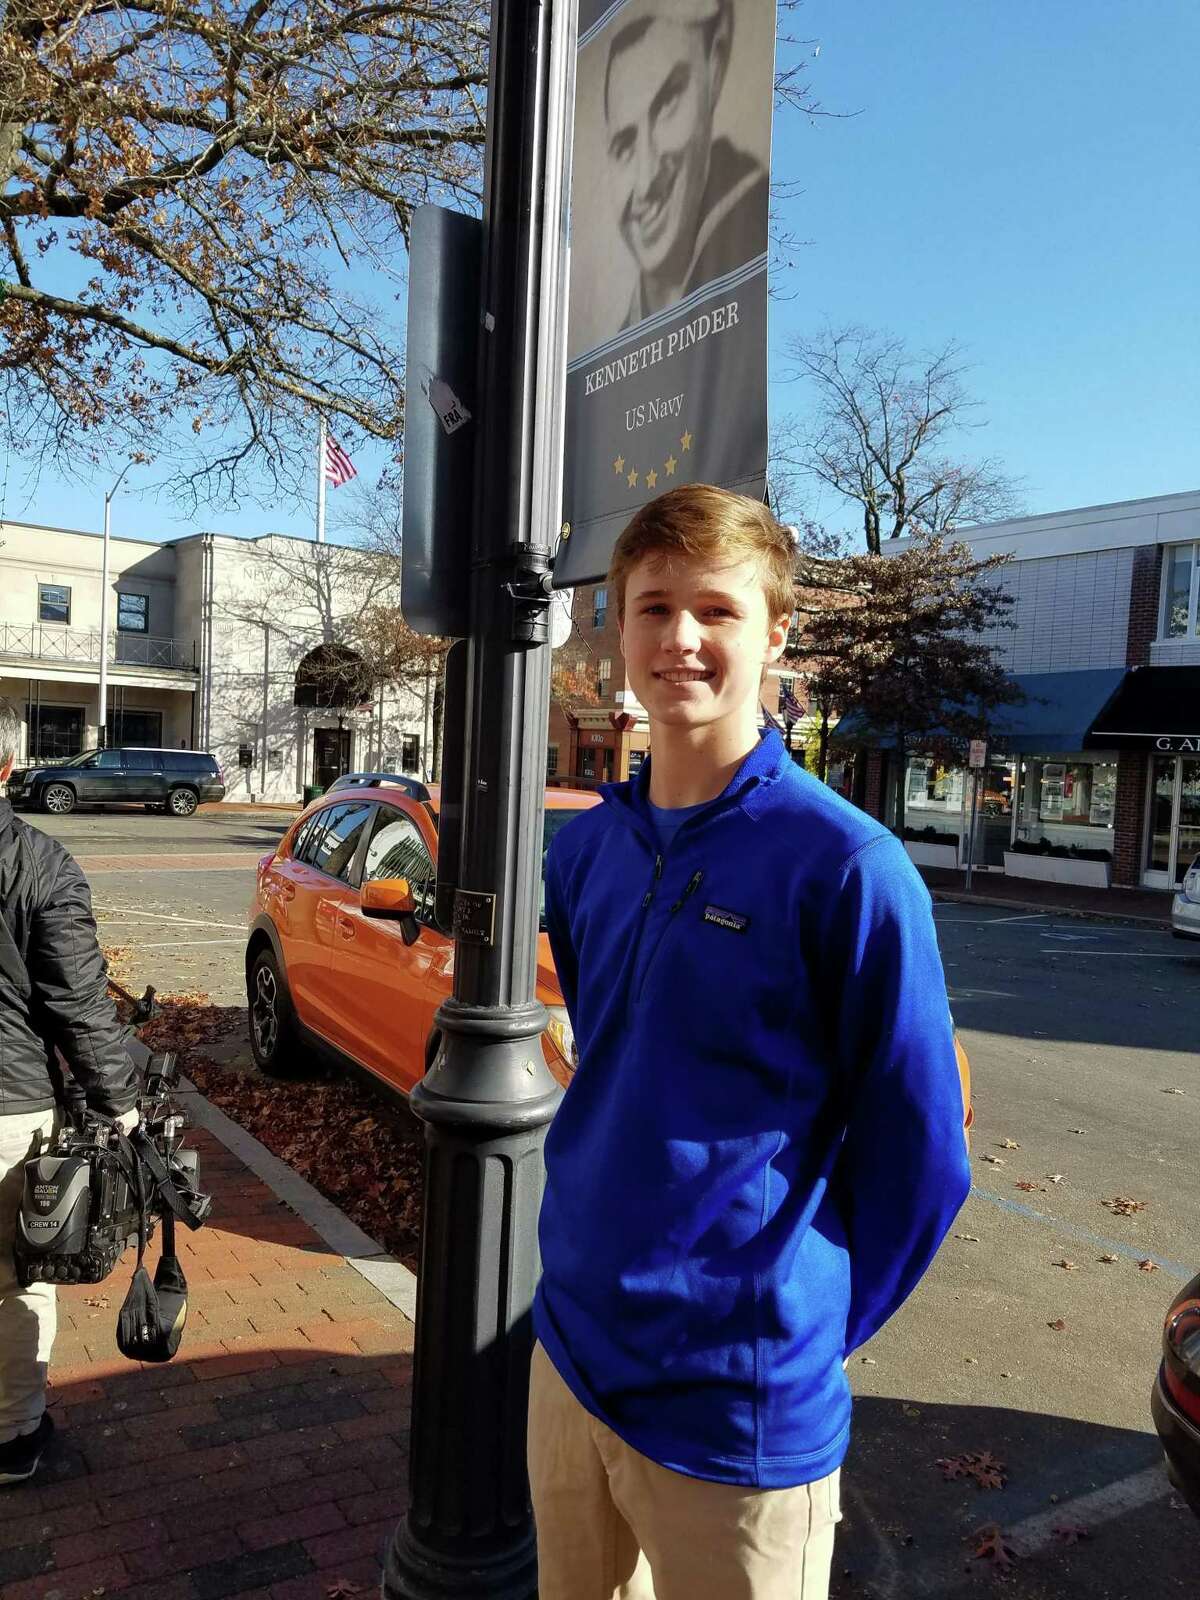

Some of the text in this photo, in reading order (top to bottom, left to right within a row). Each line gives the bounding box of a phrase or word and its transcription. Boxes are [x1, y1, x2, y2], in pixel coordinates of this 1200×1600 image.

[585, 301, 740, 395] KENNETH PINDER
[625, 394, 685, 431] US Navy
[1156, 737, 1174, 750] G.
[704, 913, 741, 930] patagonia
